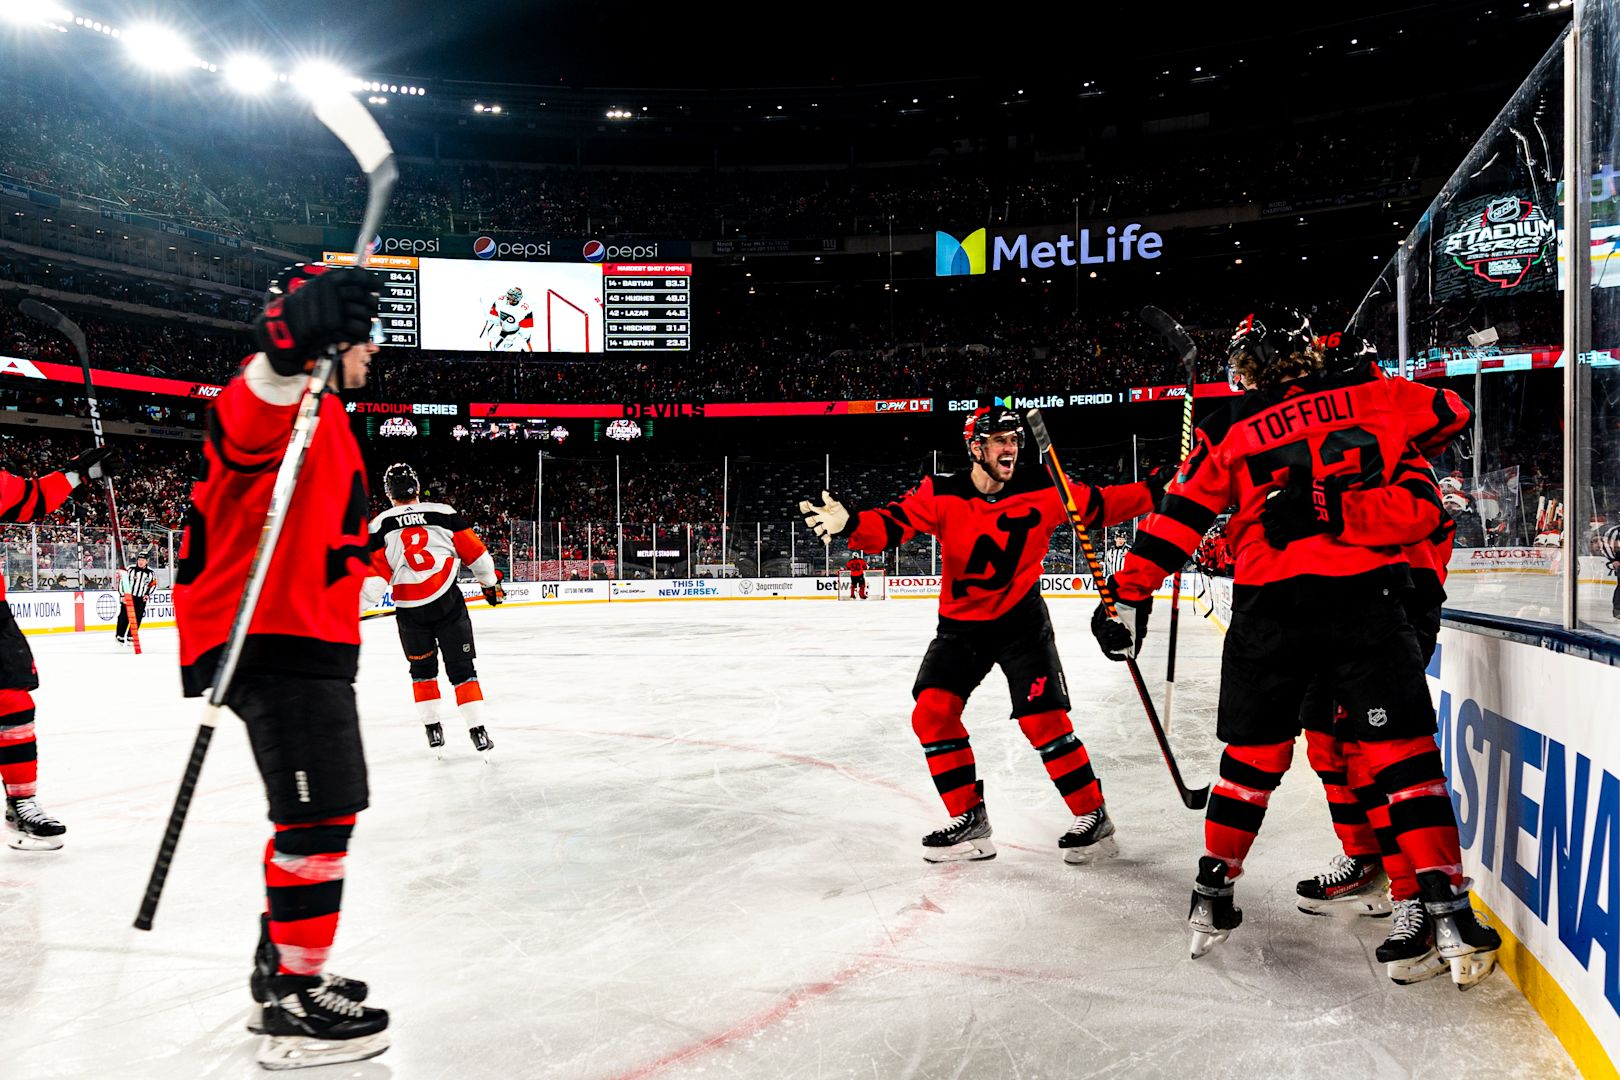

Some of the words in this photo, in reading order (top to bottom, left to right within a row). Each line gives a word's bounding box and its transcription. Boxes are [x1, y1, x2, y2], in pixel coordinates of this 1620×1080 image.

[1445, 219, 1556, 254] STADIUM
[384, 238, 440, 254] pepsi
[498, 240, 551, 258] pepsi
[606, 243, 658, 260] pepsi
[992, 224, 1163, 270] MetLife
[1461, 236, 1542, 255] SERIES
[1014, 396, 1065, 410] MetLife
[1070, 394, 1113, 406] PERIOD
[1119, 393, 1123, 402] 1
[1148, 388, 1152, 400] 1
[345, 402, 458, 416] #STADIUMSERIES
[622, 404, 705, 418] DEVILS
[948, 400, 978, 411] 6:30
[1248, 391, 1354, 446] TOFFOLI
[380, 425, 418, 436] STADIUM
[606, 426, 642, 437] STADIUM
[395, 514, 428, 527] YORK
[400, 526, 436, 572] 8
[542, 584, 559, 599] CAT
[672, 580, 693, 588] THIS
[659, 588, 680, 596] NEW
[682, 588, 719, 596] JERSEY.
[34, 602, 61, 618] VODKA
